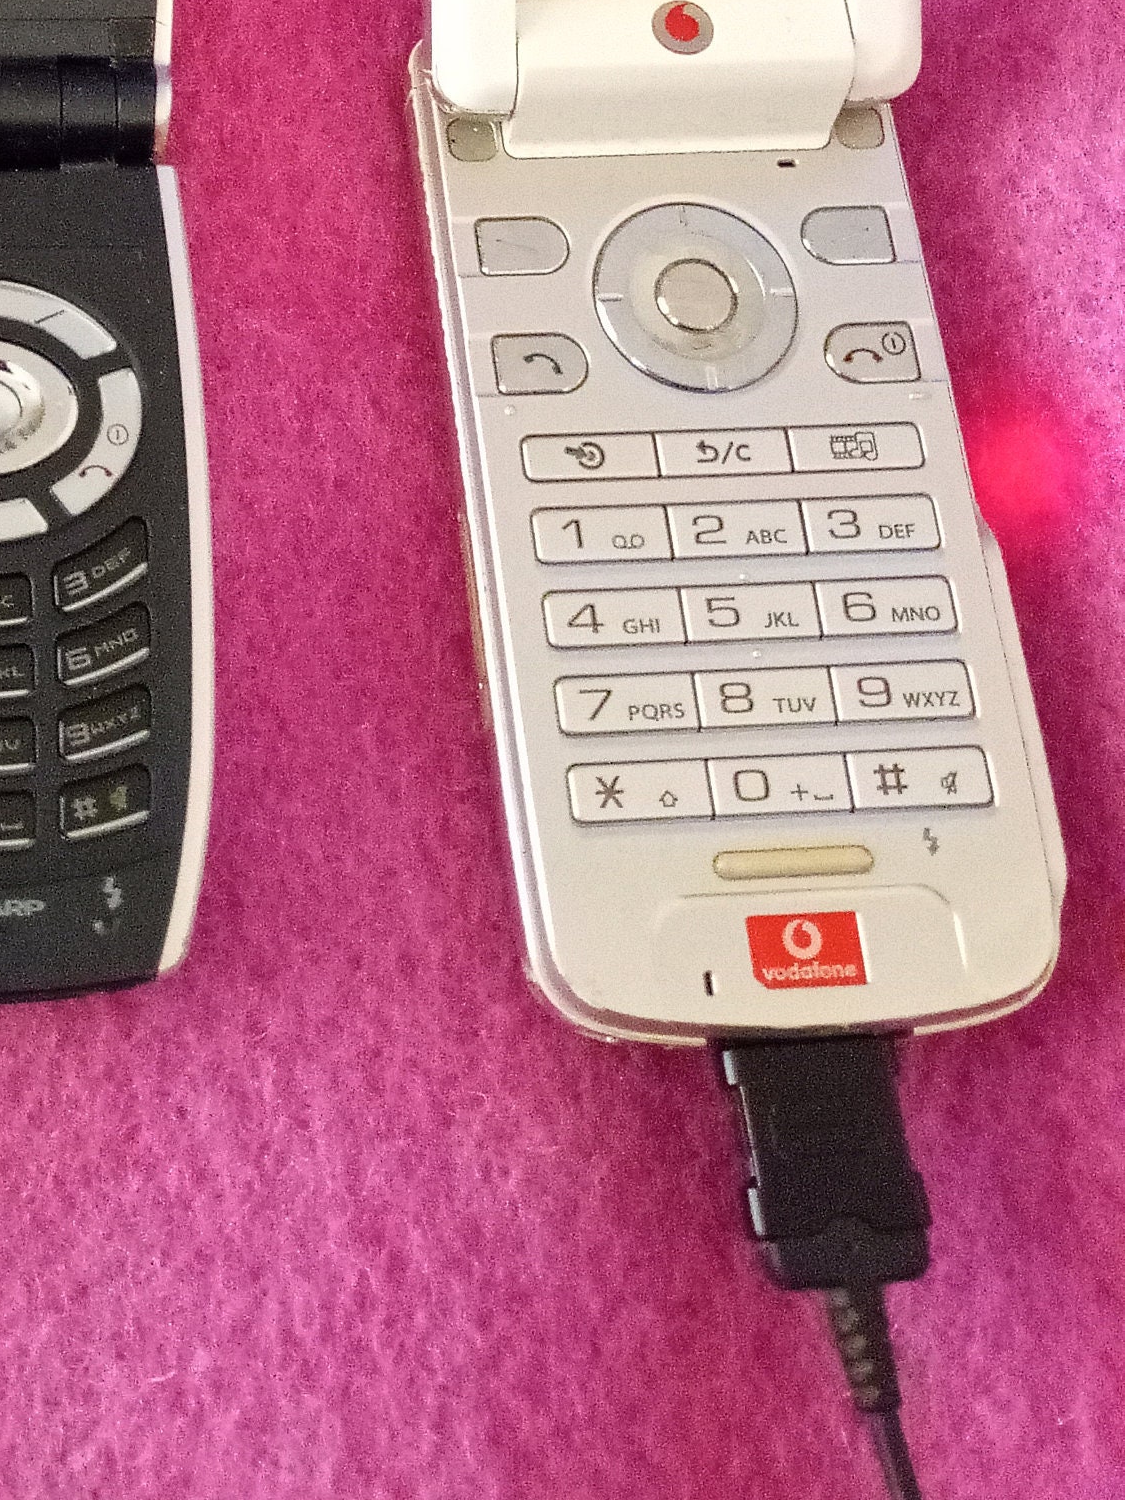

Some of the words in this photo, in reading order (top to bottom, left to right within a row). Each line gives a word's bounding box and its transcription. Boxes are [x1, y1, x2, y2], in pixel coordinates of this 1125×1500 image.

[561, 518, 587, 549] 1
[692, 514, 727, 545] 2
[745, 527, 788, 545] ABC
[826, 509, 861, 540] 3
[878, 523, 915, 540] DEF
[567, 603, 604, 634] 4
[622, 617, 661, 634] GHI
[705, 597, 742, 628] 5
[764, 611, 800, 628] JKL
[842, 591, 877, 622] 6
[891, 605, 941, 623] MNO
[578, 688, 613, 721] 7
[628, 701, 685, 722] PQRS
[719, 682, 755, 713] 8
[774, 696, 817, 713] TUV
[856, 676, 892, 708] 9
[902, 691, 960, 708] WXYZ
[732, 769, 770, 801] 0
[762, 961, 857, 980] vodafone
